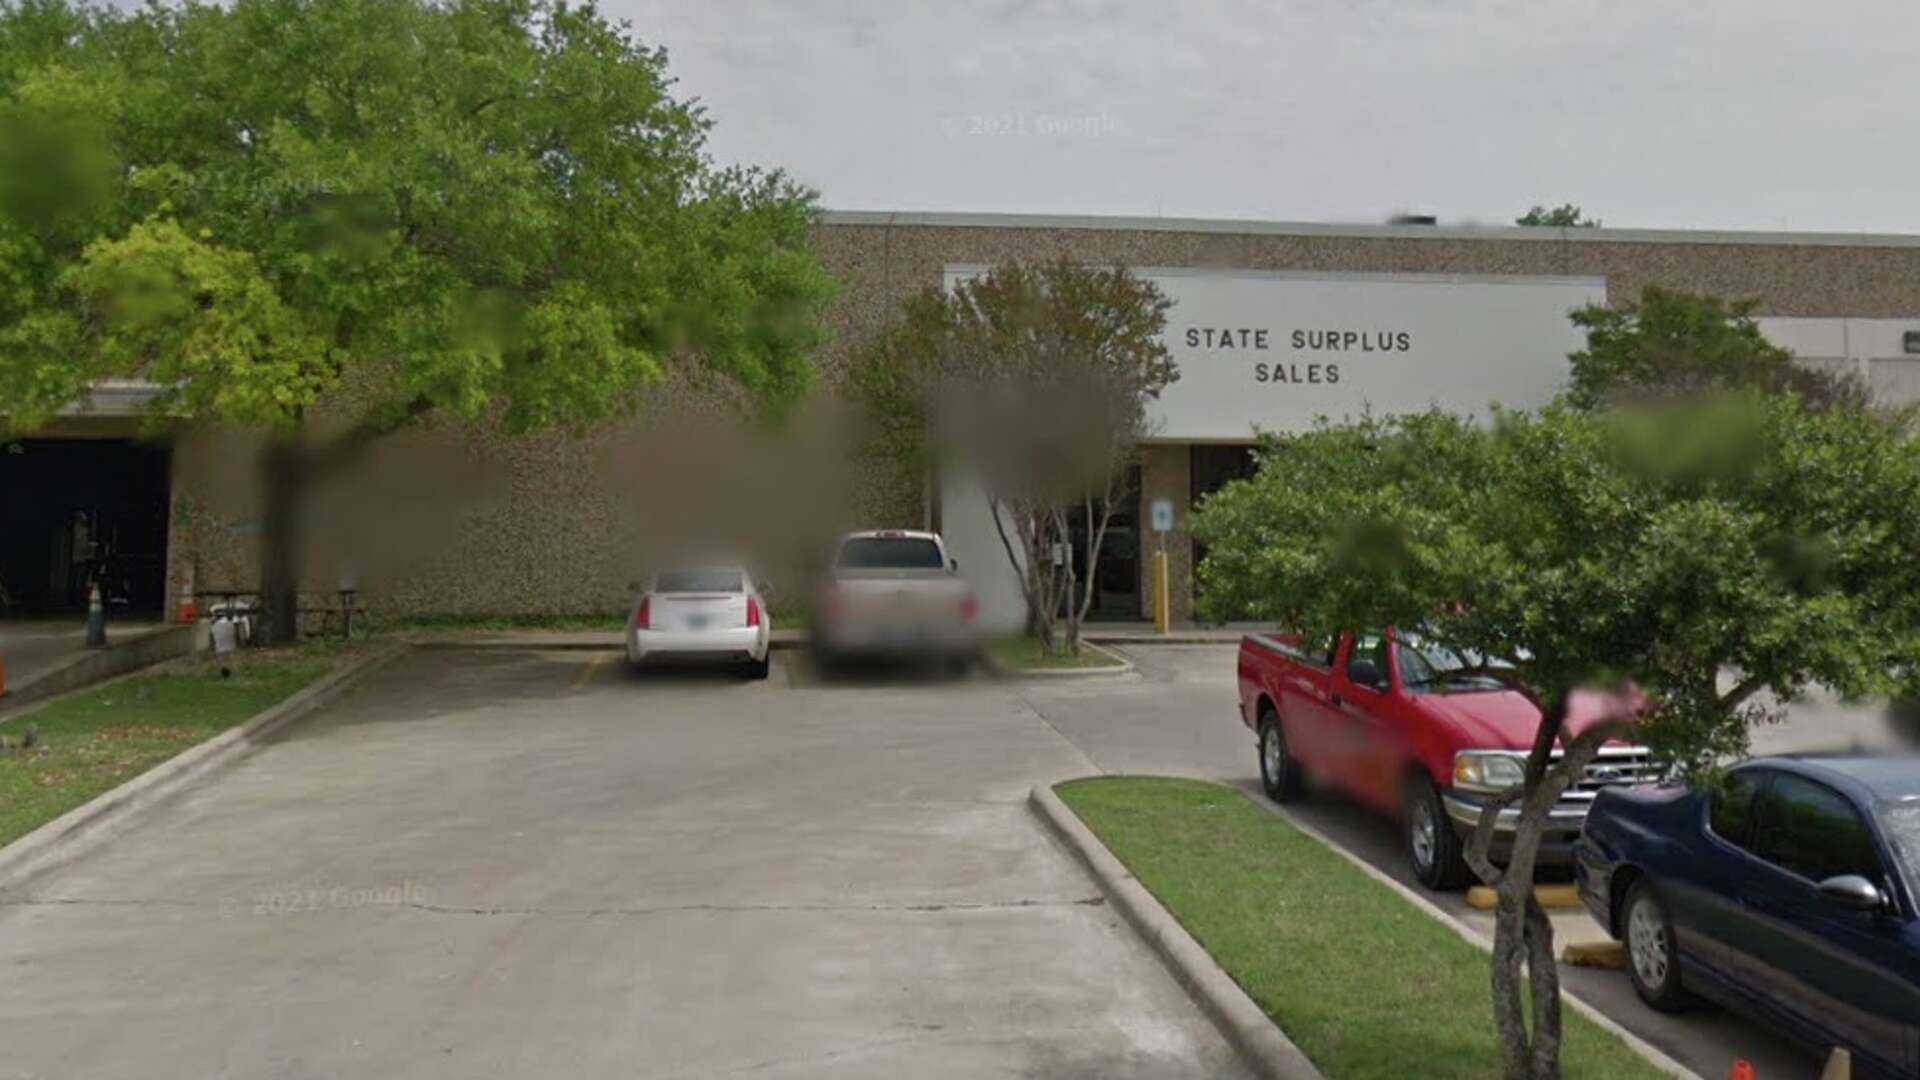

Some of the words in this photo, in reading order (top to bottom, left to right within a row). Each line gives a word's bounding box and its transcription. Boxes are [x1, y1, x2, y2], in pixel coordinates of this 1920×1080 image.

[1186, 329, 1269, 349] STATE
[1292, 329, 1411, 351] SURPLUS
[1255, 363, 1340, 383] SALES
